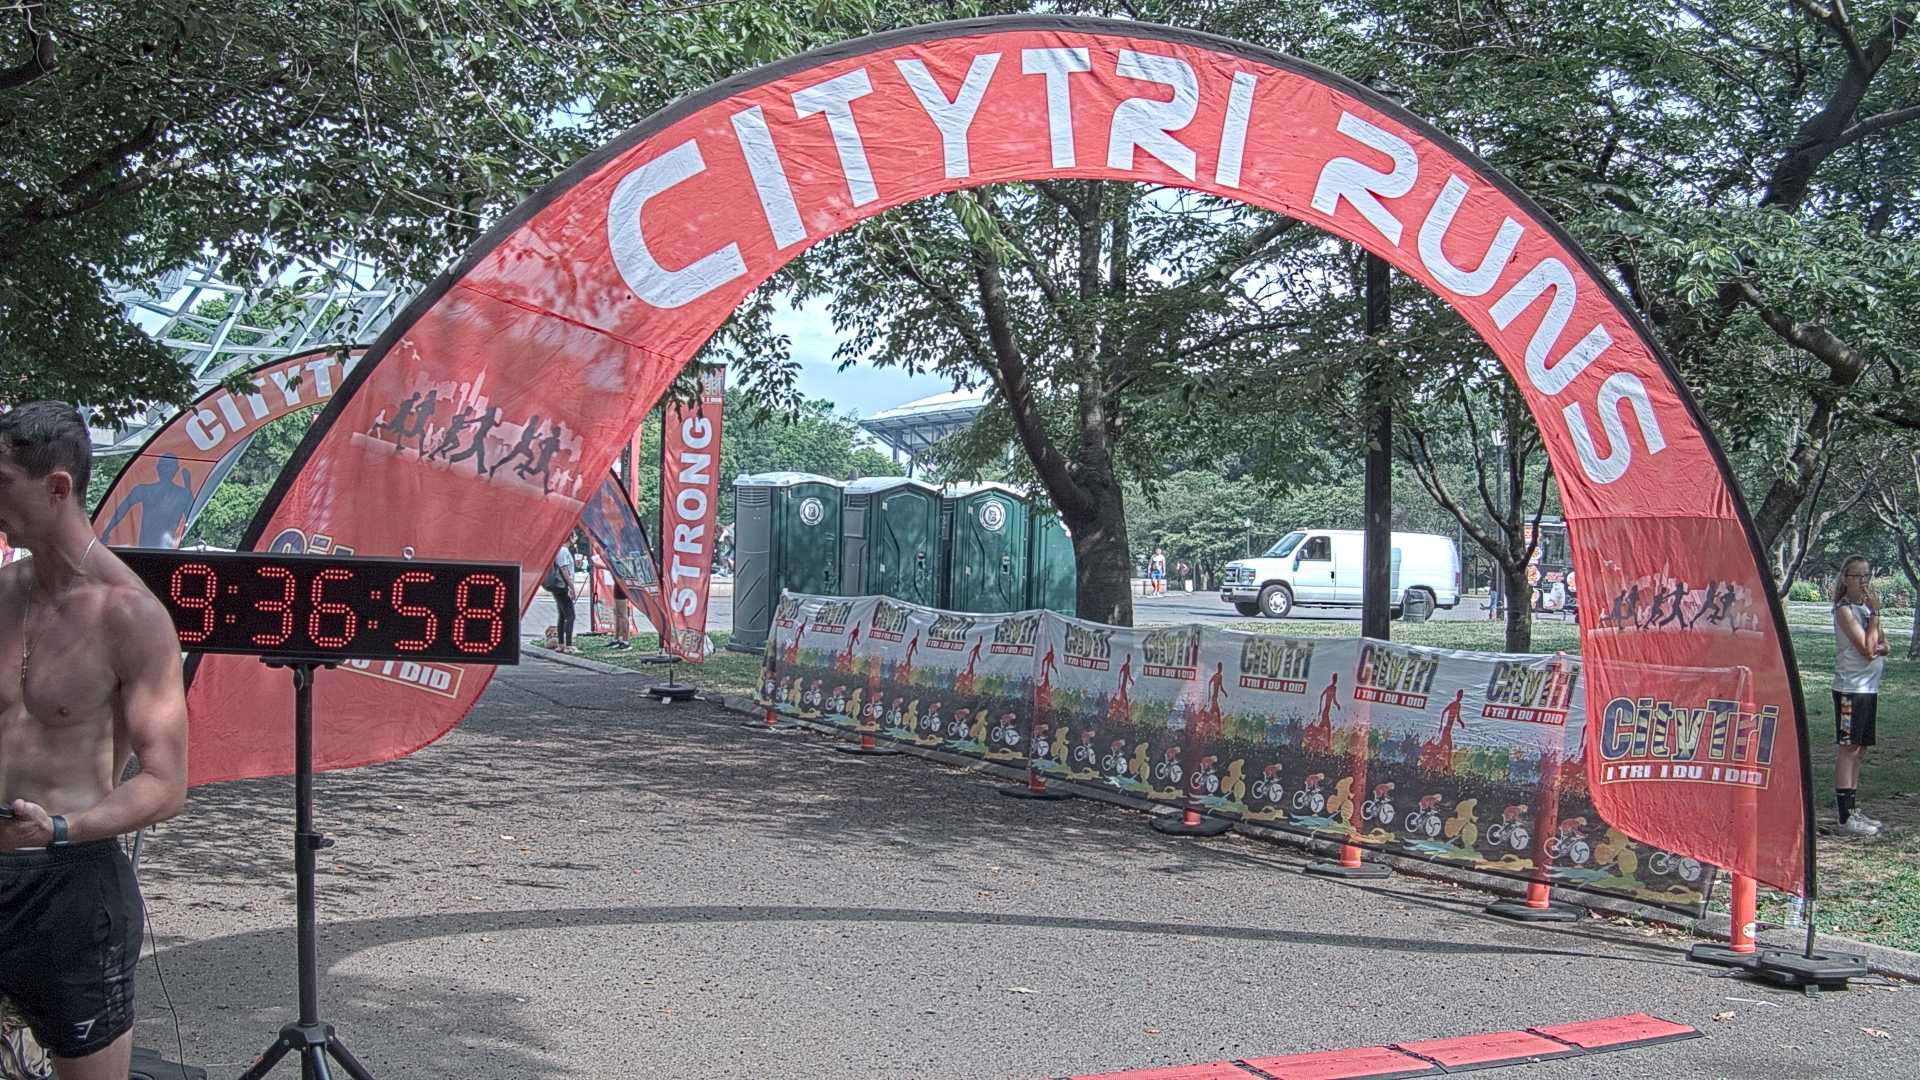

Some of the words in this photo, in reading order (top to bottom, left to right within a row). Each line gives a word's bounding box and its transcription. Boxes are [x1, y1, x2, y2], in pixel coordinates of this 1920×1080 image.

[1311, 111, 1665, 484] RUNS
[671, 416, 713, 618] STRONG
[171, 564, 506, 653] 9:36:58
[399, 661, 452, 691] DID
[1492, 706, 1510, 719] TRI
[1543, 712, 1564, 724] DID
[1599, 697, 1780, 765] CityTri
[1606, 766, 1615, 781] I
[1618, 765, 1651, 779] TRI
[1660, 765, 1668, 778] I
[1711, 767, 1720, 781] I
[1724, 768, 1763, 785] DID
